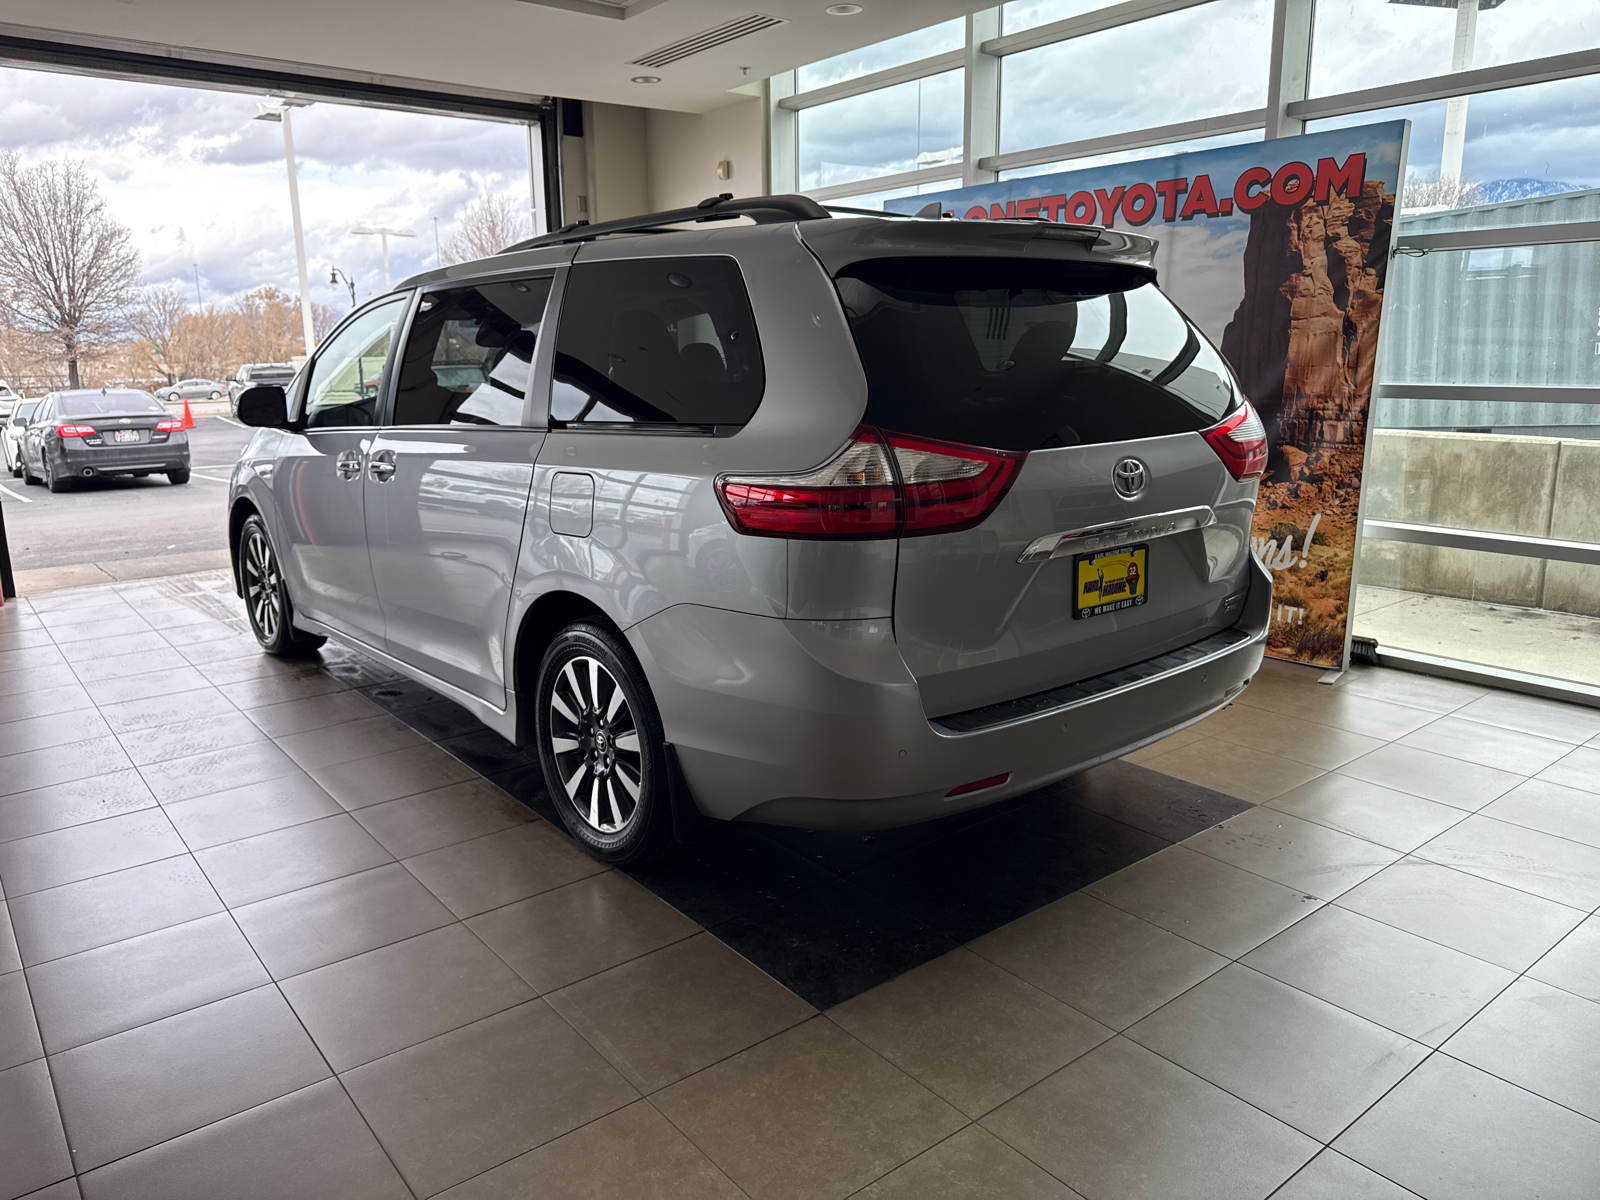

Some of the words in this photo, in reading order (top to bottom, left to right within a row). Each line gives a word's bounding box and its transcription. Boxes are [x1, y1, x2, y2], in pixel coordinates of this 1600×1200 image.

[946, 153, 1367, 228] ETOYOTA.COM
[1084, 522, 1177, 550] SIENNA
[1130, 566, 1136, 576] 32
[1083, 579, 1100, 595] KARL
[1102, 581, 1127, 597] MALONE
[1094, 606, 1102, 614] WE
[1102, 603, 1116, 612] MAKE
[1122, 600, 1132, 608] EASY
[1277, 604, 1304, 625] IT!
